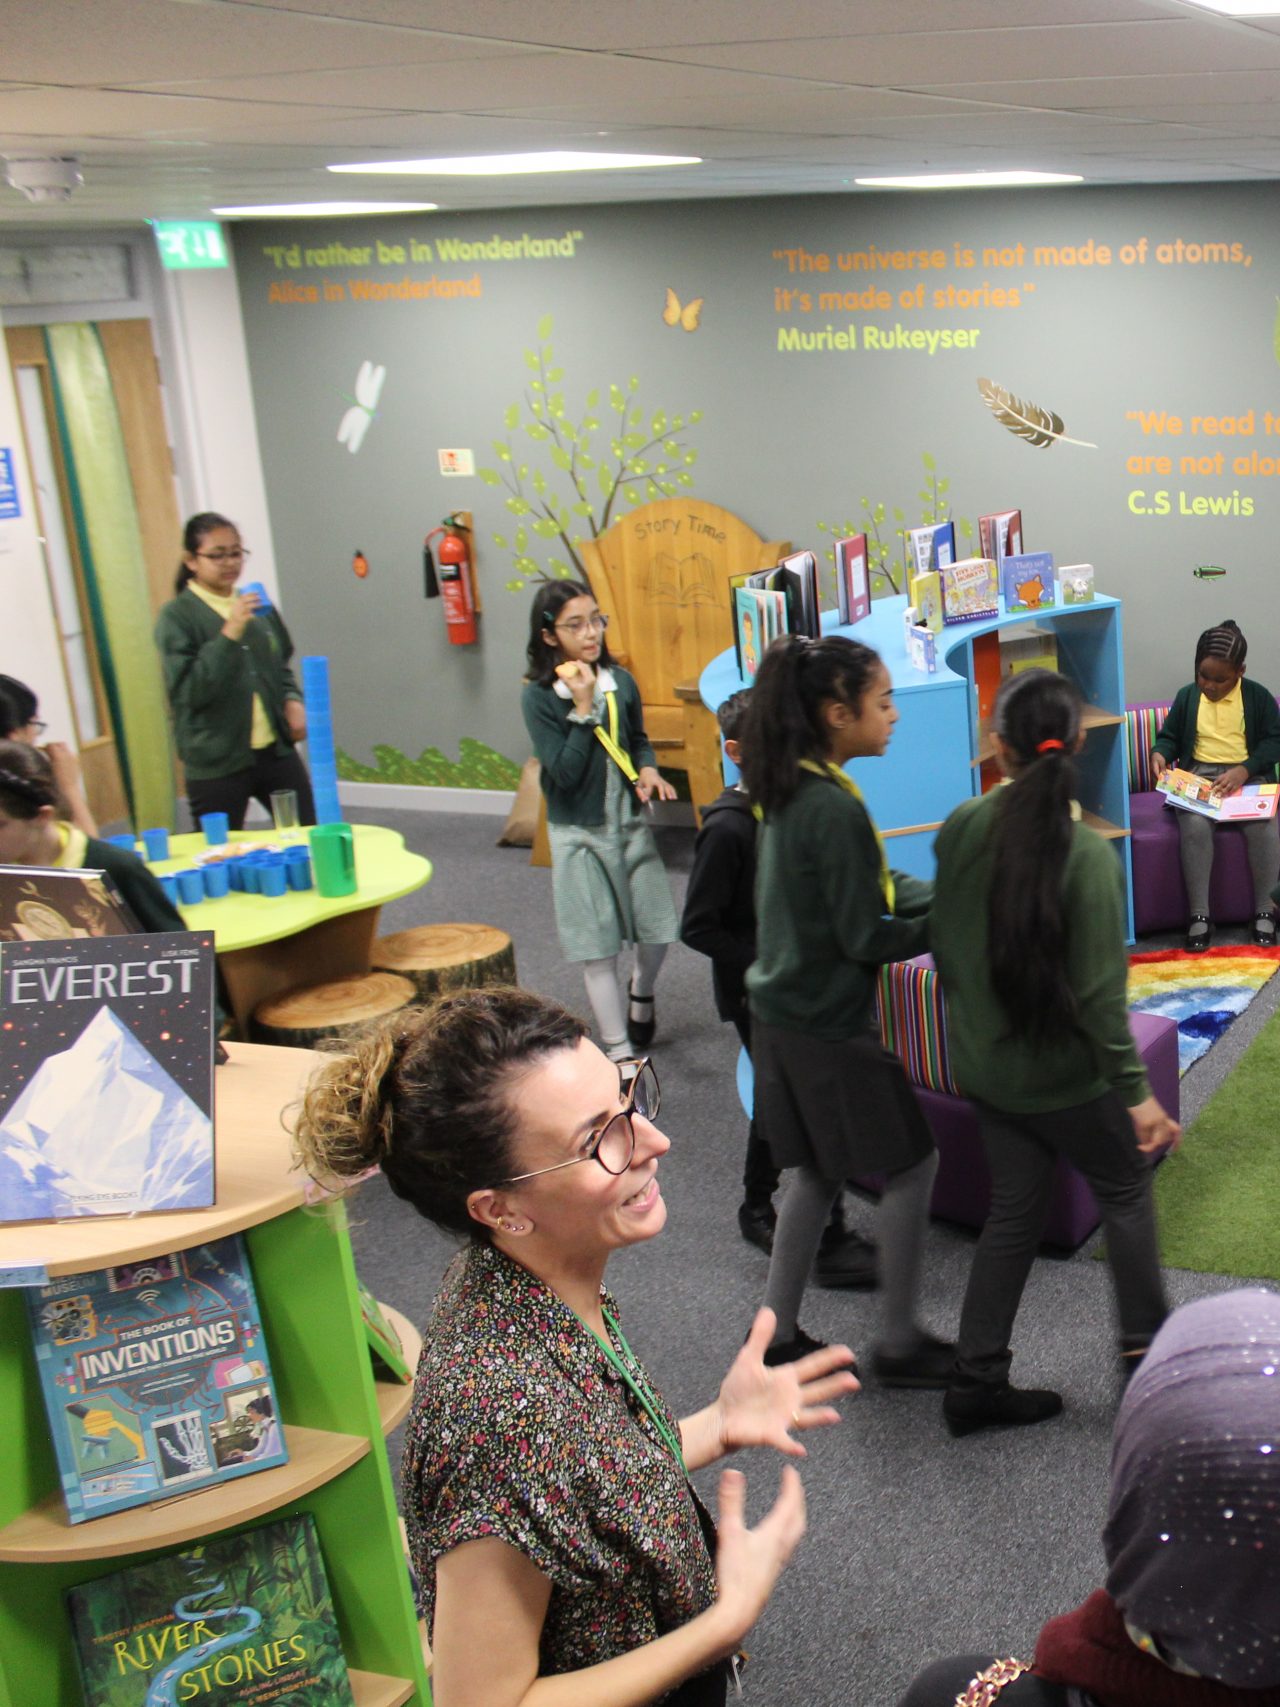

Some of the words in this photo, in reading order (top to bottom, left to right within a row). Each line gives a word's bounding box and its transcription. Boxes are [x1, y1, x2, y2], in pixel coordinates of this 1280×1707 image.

[304, 243, 372, 267] rather
[377, 241, 406, 265] be
[411, 239, 433, 262] in
[435, 231, 583, 262] Wonderland"
[773, 248, 831, 272] "The
[838, 246, 946, 272] universe
[955, 243, 976, 268] is
[983, 243, 1025, 267] not
[1034, 240, 1111, 266] made
[1119, 238, 1147, 265] of
[1156, 239, 1252, 267] atoms,
[269, 281, 319, 303] Alice
[324, 280, 345, 301] in
[348, 275, 481, 300] Wonderland
[775, 288, 812, 312] it's
[819, 286, 892, 311] made
[899, 284, 925, 309] of
[934, 283, 1035, 309] stories"
[778, 325, 857, 352] Muriel
[863, 324, 980, 354] Rukeyser
[1127, 412, 1183, 435] "We
[1191, 411, 1255, 436] read
[1126, 456, 1172, 475] are
[1180, 453, 1224, 475] not
[1128, 490, 1172, 515] C.S
[1179, 491, 1254, 516] Lewis
[634, 518, 680, 540] Story
[687, 514, 727, 543] Time
[11, 958, 200, 1004] EVEREST
[120, 1329, 142, 1341] THE
[143, 1322, 175, 1336] BOOK
[176, 1316, 192, 1328] OF
[81, 1320, 235, 1379] INVENTIONS
[114, 1620, 228, 1675] RIVER
[180, 1634, 306, 1701] STORIES
